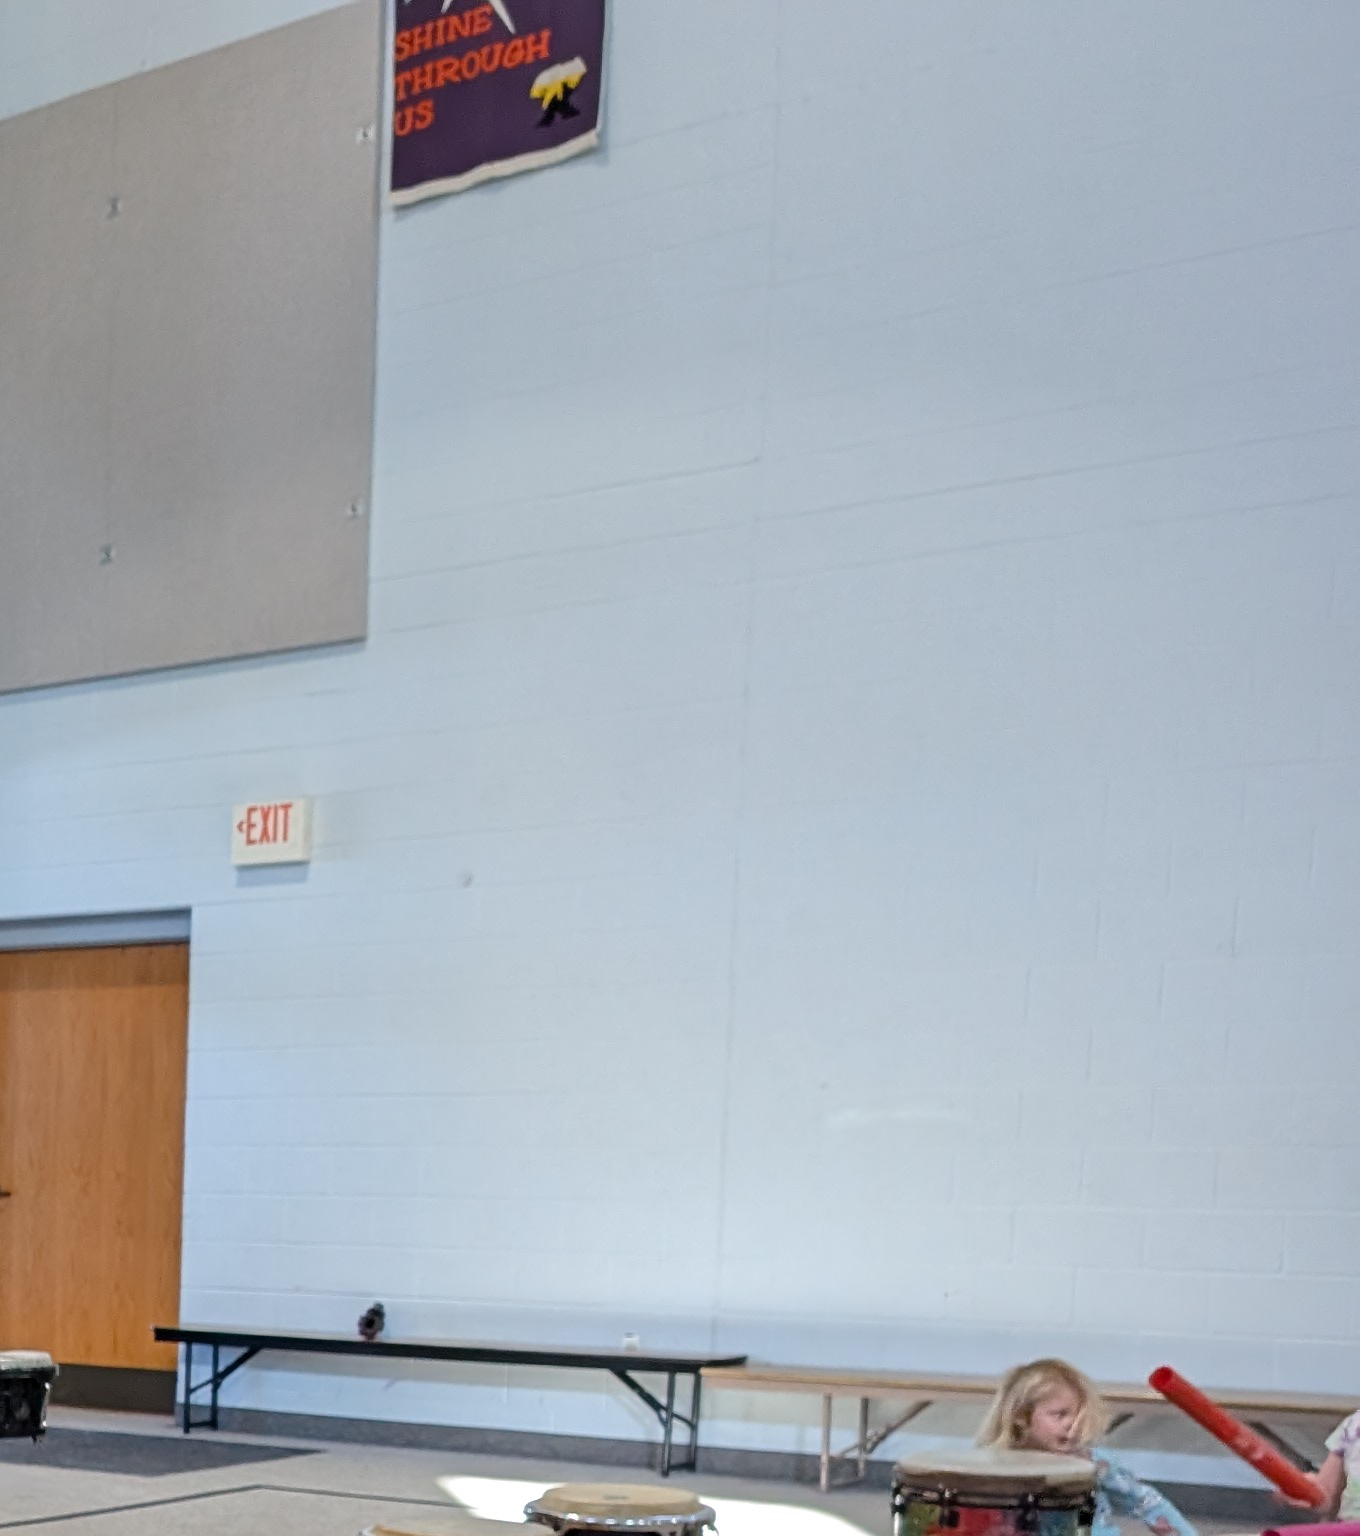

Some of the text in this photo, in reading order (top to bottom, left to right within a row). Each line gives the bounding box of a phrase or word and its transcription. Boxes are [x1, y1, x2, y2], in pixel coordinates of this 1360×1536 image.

[395, 4, 494, 62] SHINE
[395, 28, 552, 102] THROUGH
[394, 99, 435, 137] US
[246, 801, 293, 846] EXIT
